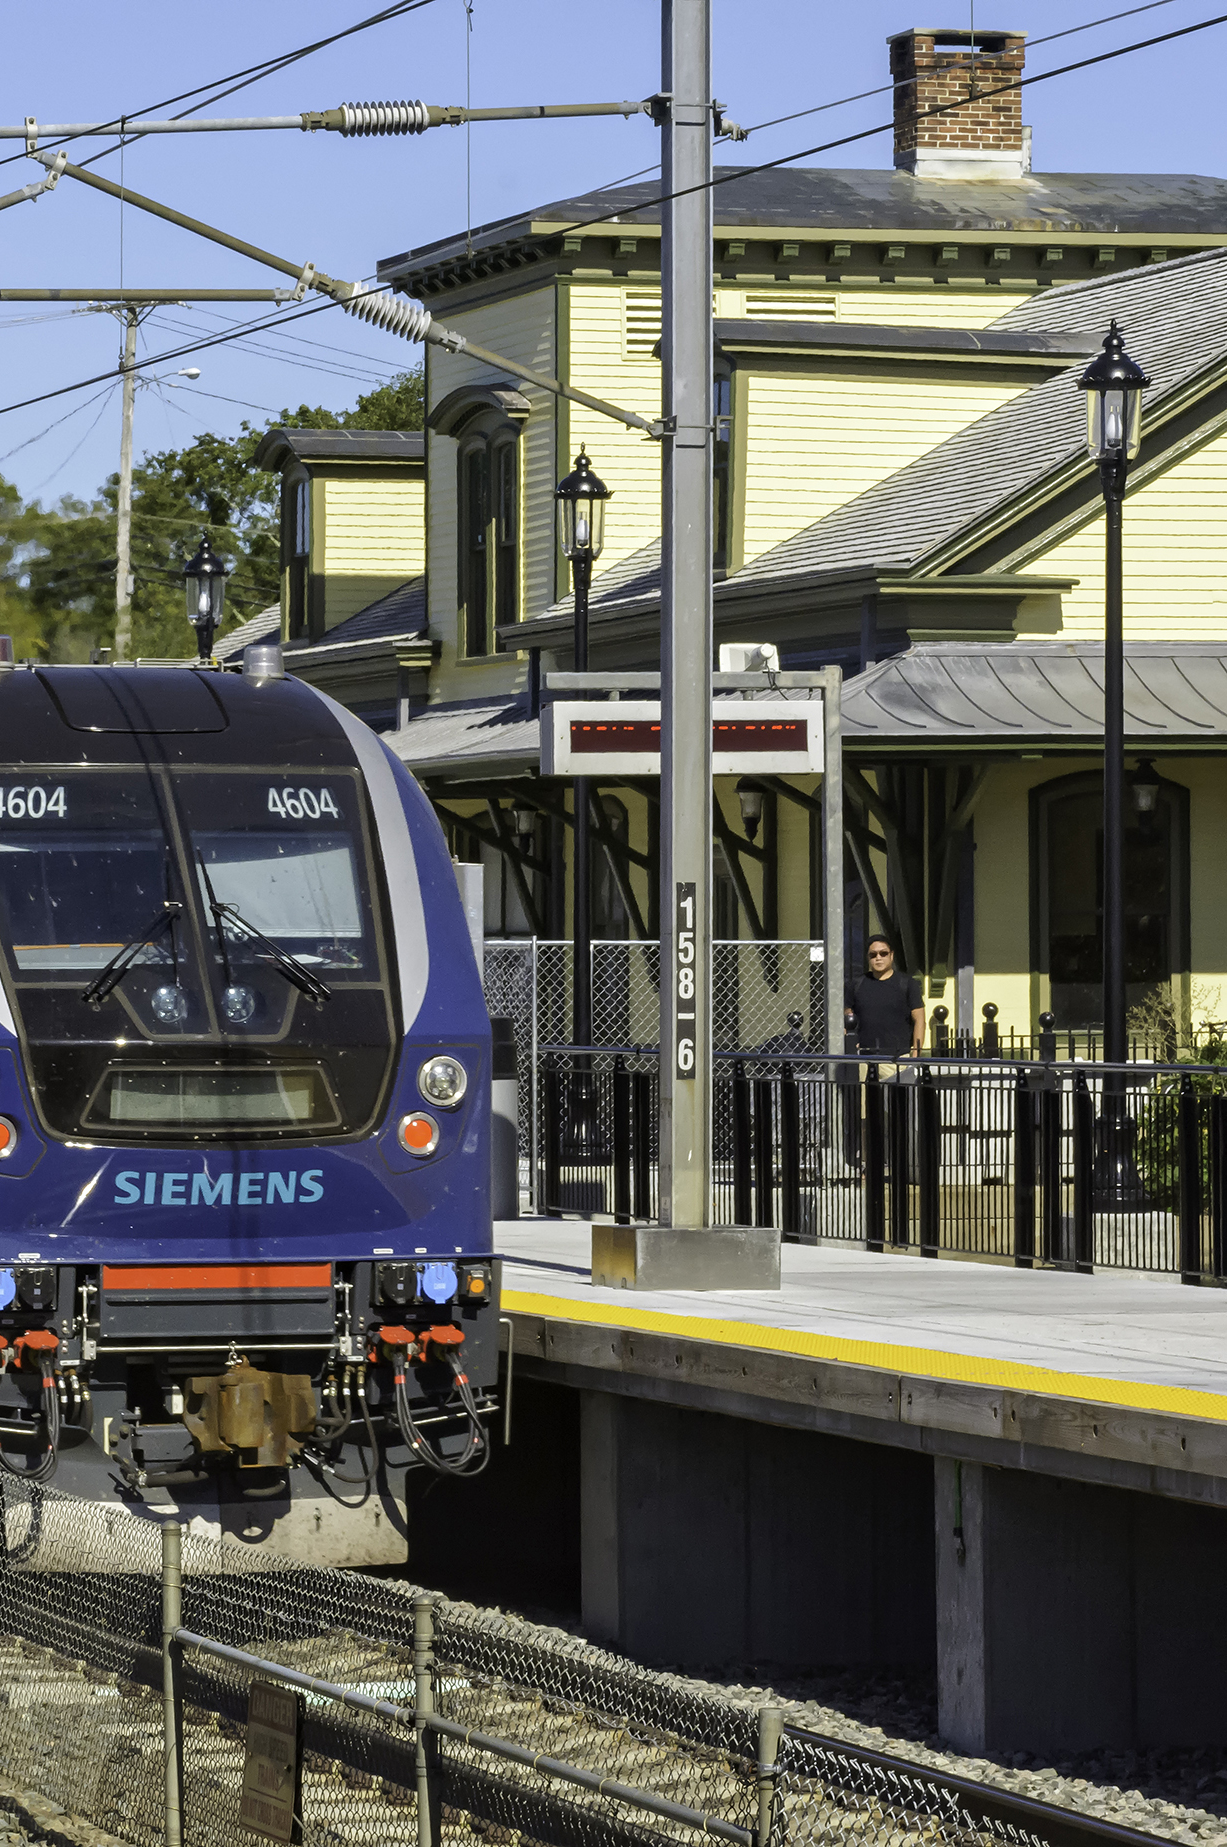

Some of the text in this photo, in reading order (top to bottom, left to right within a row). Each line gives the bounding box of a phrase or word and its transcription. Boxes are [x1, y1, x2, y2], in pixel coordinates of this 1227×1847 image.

[267, 787, 339, 819] 4604
[114, 1169, 325, 1206] SIEMENS
[251, 1690, 294, 1728] DANGER
